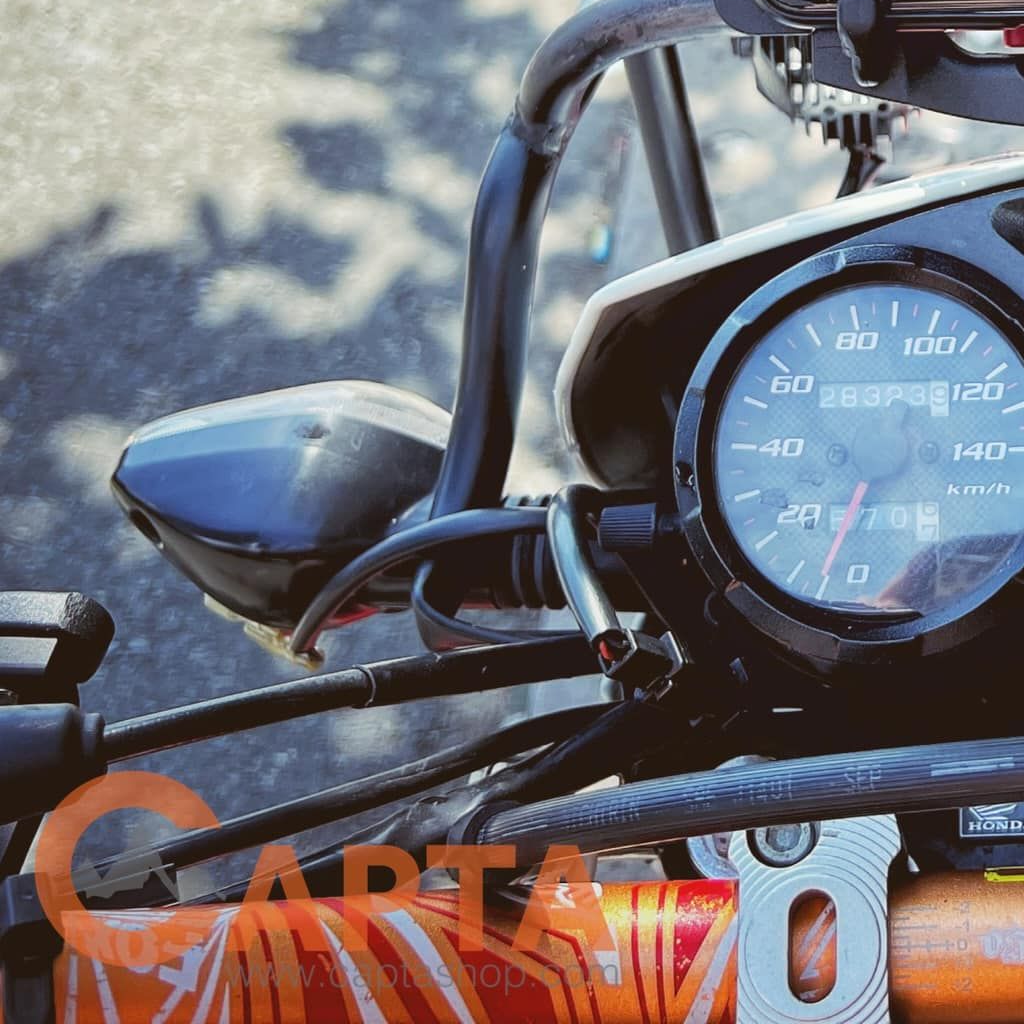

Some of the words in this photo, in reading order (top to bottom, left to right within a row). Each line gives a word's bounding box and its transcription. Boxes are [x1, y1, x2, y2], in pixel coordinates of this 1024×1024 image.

[835, 331, 879, 350] 80
[904, 336, 957, 355] 100
[770, 375, 815, 394] 60
[952, 381, 1004, 401] 120
[759, 438, 804, 457] 40
[953, 442, 1007, 461] 140
[947, 482, 1011, 496] km/h
[777, 504, 821, 528] 20
[847, 564, 870, 584] 0
